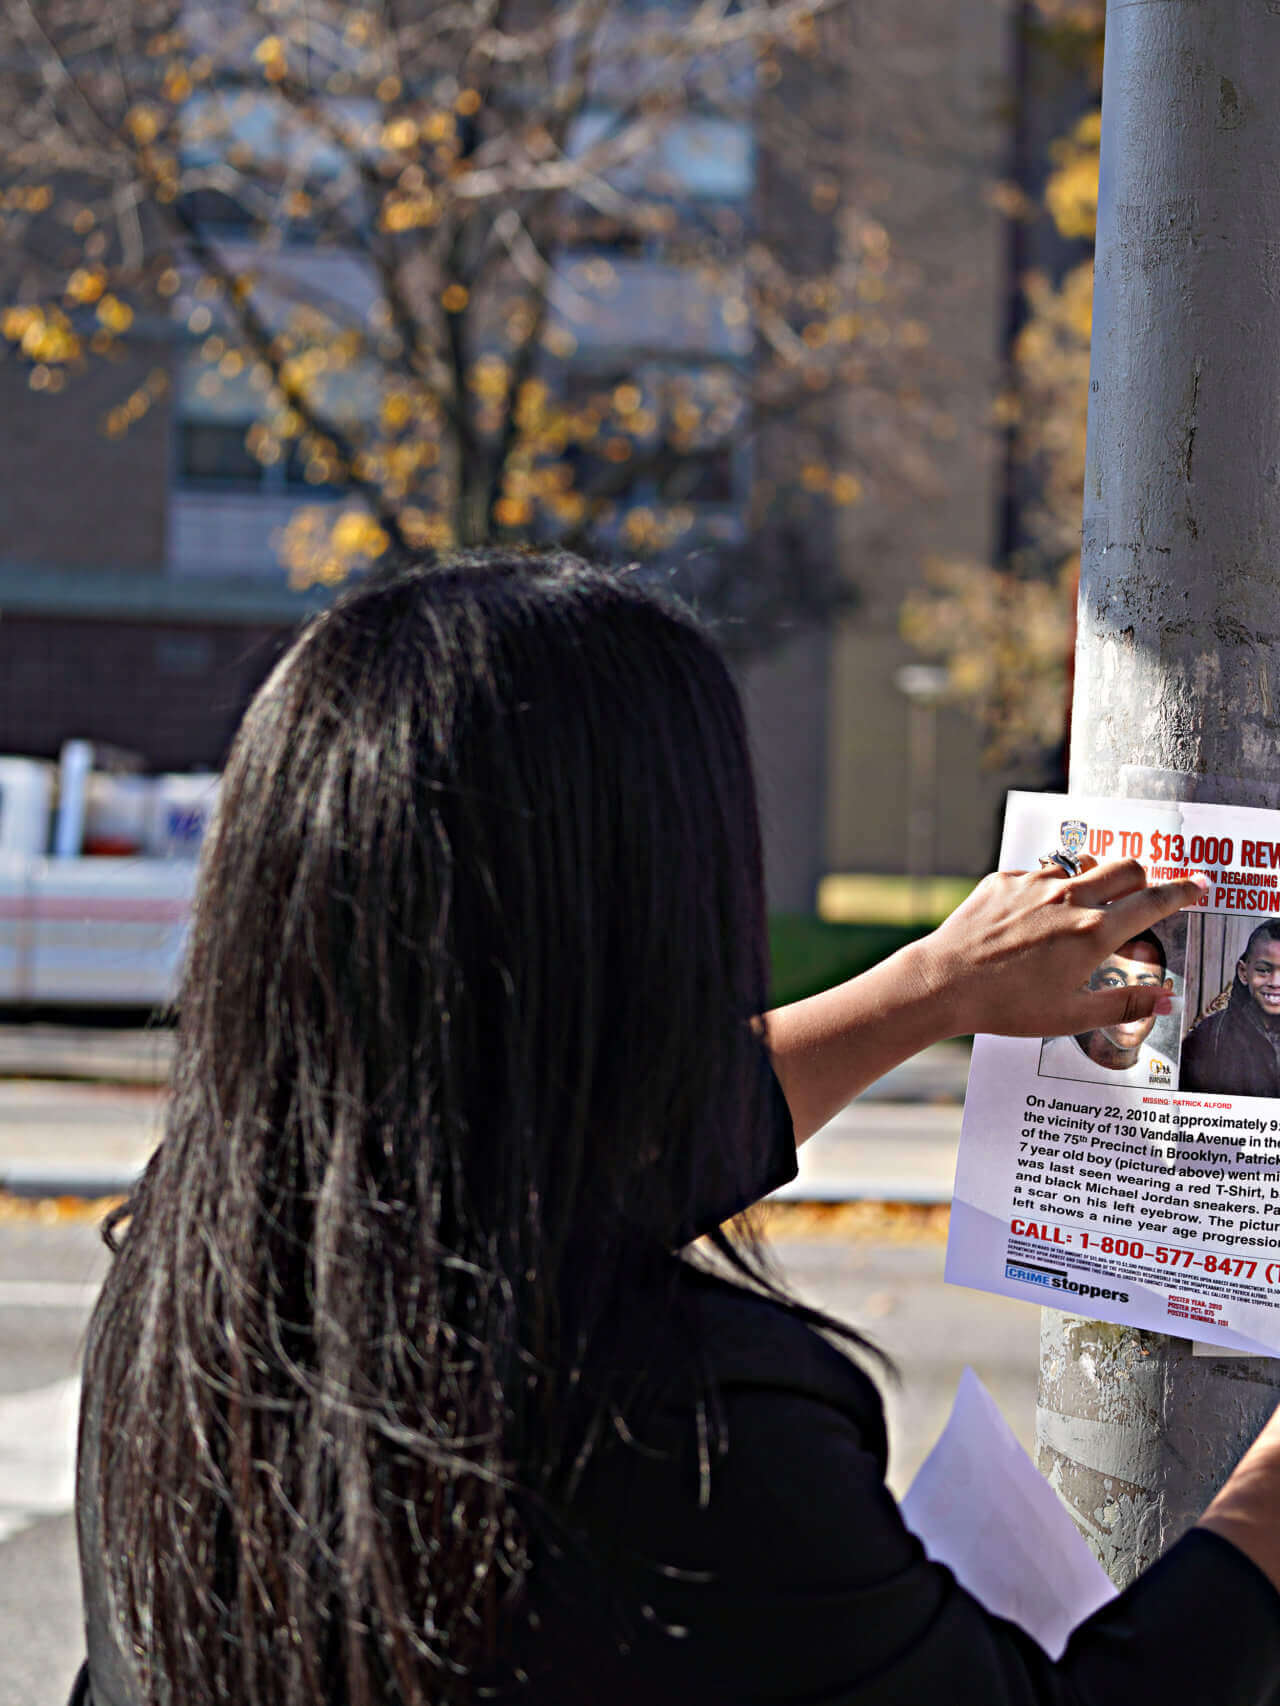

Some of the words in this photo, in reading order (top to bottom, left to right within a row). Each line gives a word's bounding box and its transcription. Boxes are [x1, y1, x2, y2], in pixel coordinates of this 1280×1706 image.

[1088, 829, 1114, 856] UP
[1119, 831, 1143, 858] TO
[1150, 830, 1233, 867] $13,000
[1221, 871, 1278, 888] REGARDING
[1216, 888, 1280, 912] PERSON
[1026, 1095, 1045, 1107] On
[1048, 1099, 1101, 1118] January
[1104, 1106, 1123, 1120] 22,
[1126, 1109, 1156, 1122] 2010
[1159, 1114, 1170, 1124] at
[1173, 1116, 1267, 1133] approximately
[1172, 1099, 1202, 1107] PATRICK
[1021, 1128, 1035, 1137] of
[1039, 1130, 1060, 1142] the
[1063, 1134, 1087, 1145] 75th
[1091, 1137, 1146, 1156] Precinct
[1151, 1146, 1162, 1157] in
[1166, 1148, 1231, 1165] Brooklyn,
[1024, 1112, 1044, 1124] the
[1048, 1116, 1095, 1133] vicinity
[1097, 1123, 1112, 1133] of
[1115, 1125, 1136, 1137] 130
[1197, 1133, 1246, 1146] Avenue
[1250, 1136, 1261, 1147] in
[1018, 1158, 1044, 1170] was
[1050, 1162, 1075, 1174] last
[1079, 1168, 1111, 1180] seen
[1117, 1174, 1170, 1192] wearing
[1176, 1183, 1183, 1191] a
[1189, 1184, 1210, 1194] red
[1216, 1184, 1265, 1199] T-Shirt,
[1020, 1142, 1027, 1152] 7
[1030, 1145, 1060, 1156] year
[1063, 1150, 1084, 1162] old
[1087, 1152, 1112, 1168] boy
[1115, 1157, 1175, 1176] (pictured
[1179, 1164, 1224, 1181] above)
[1228, 1170, 1259, 1181] went
[1014, 1185, 1022, 1194] a
[1028, 1188, 1058, 1200] scar
[1063, 1194, 1080, 1204] on
[1087, 1197, 1107, 1208] his
[1113, 1200, 1135, 1213] left
[1141, 1207, 1202, 1224] eyebrow.
[1208, 1215, 1234, 1227] The
[1016, 1171, 1041, 1183] and
[1045, 1176, 1081, 1190] black
[1086, 1182, 1138, 1200] Michael
[1141, 1191, 1189, 1207] Jordan
[1193, 1199, 1259, 1214] sneakers.
[1013, 1197, 1034, 1209] left
[1040, 1202, 1084, 1219] shows
[1089, 1213, 1097, 1221] a
[1103, 1214, 1132, 1226] nine
[1138, 1221, 1167, 1231] year
[1172, 1227, 1197, 1238] age
[1010, 1218, 1072, 1245] CALL:
[1079, 1232, 1259, 1280] 1-800-577-8477
[1008, 1266, 1050, 1286] CRIME
[1051, 1277, 1130, 1303] stoppers
[1168, 1295, 1189, 1304] POSTER
[1168, 1302, 1189, 1311] POSTER
[1168, 1309, 1188, 1318] POSTER
